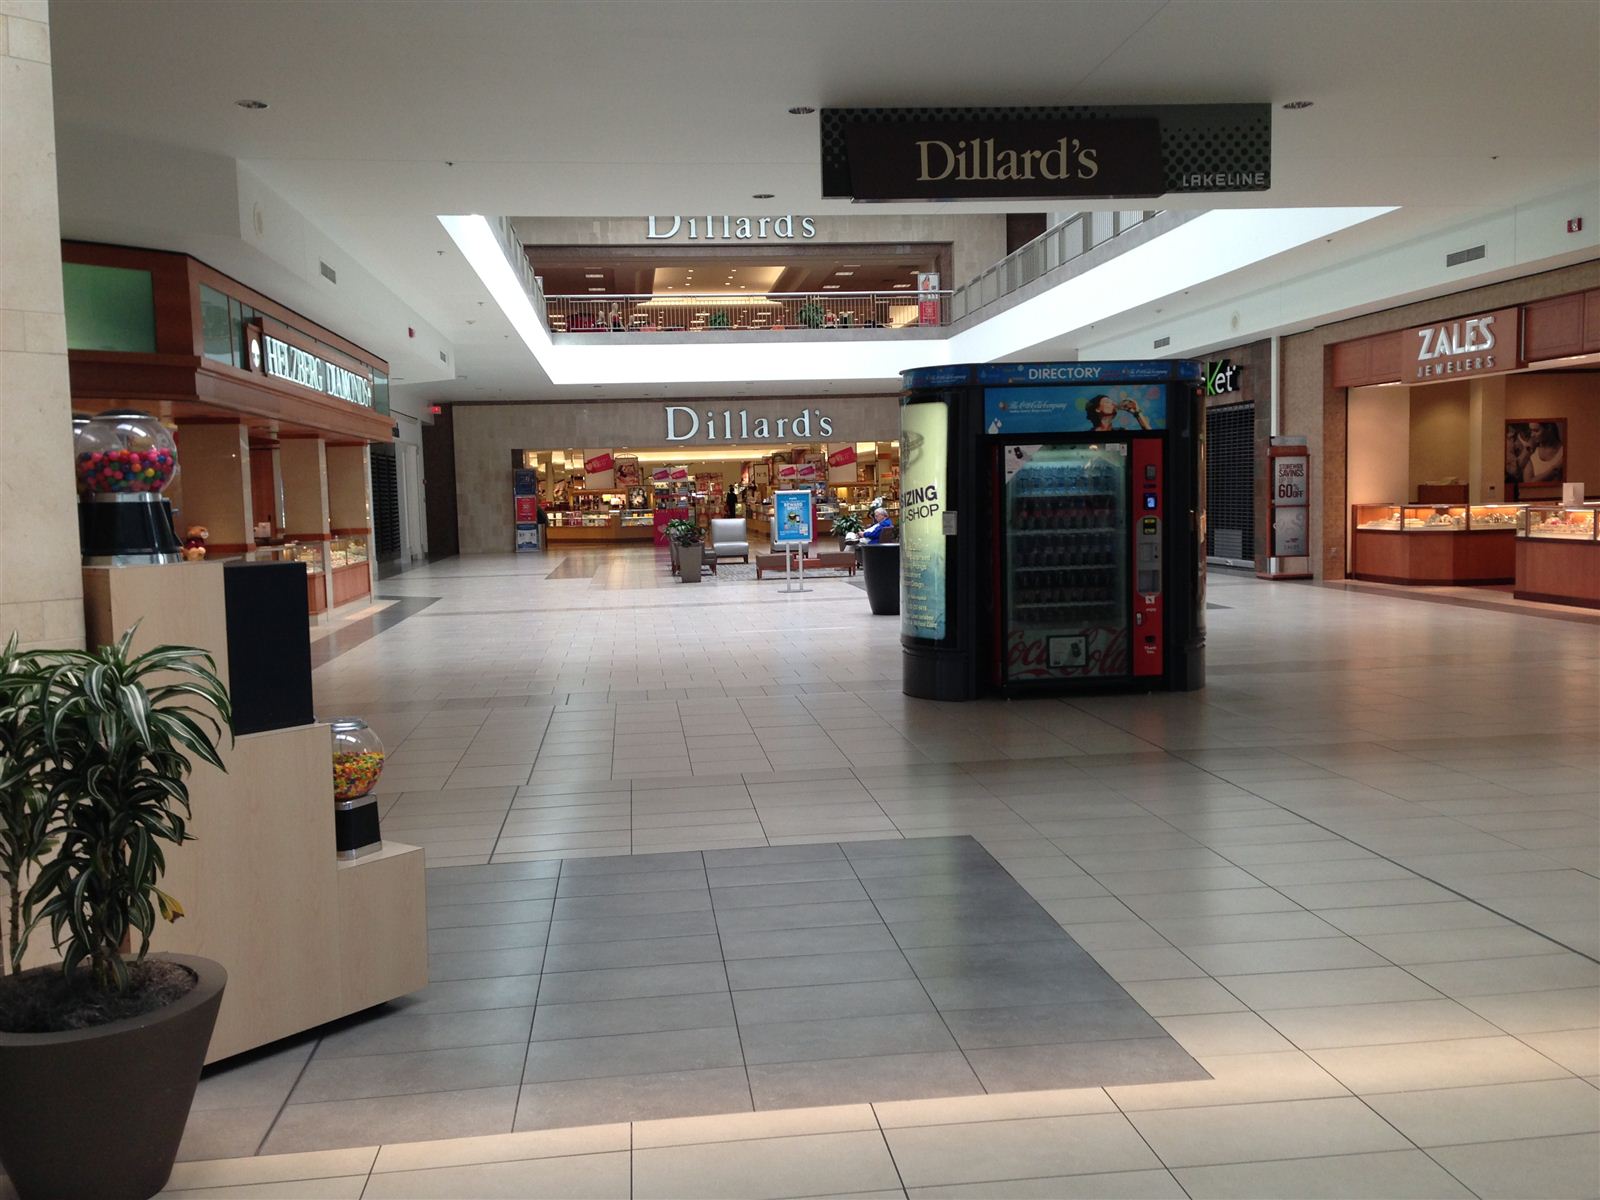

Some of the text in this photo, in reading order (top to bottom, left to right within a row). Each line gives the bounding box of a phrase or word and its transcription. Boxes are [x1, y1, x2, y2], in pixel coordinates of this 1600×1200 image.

[915, 136, 1099, 181] Dillard's
[1182, 173, 1265, 187] LAKELINE
[646, 215, 816, 239] Dillards
[1418, 316, 1495, 360] ZALES
[265, 335, 369, 407] HELZBERG DIAMONDS
[1028, 367, 1101, 380] DIRECTORY
[1417, 355, 1494, 378] JEWELERS
[665, 406, 833, 441] Dillard's
